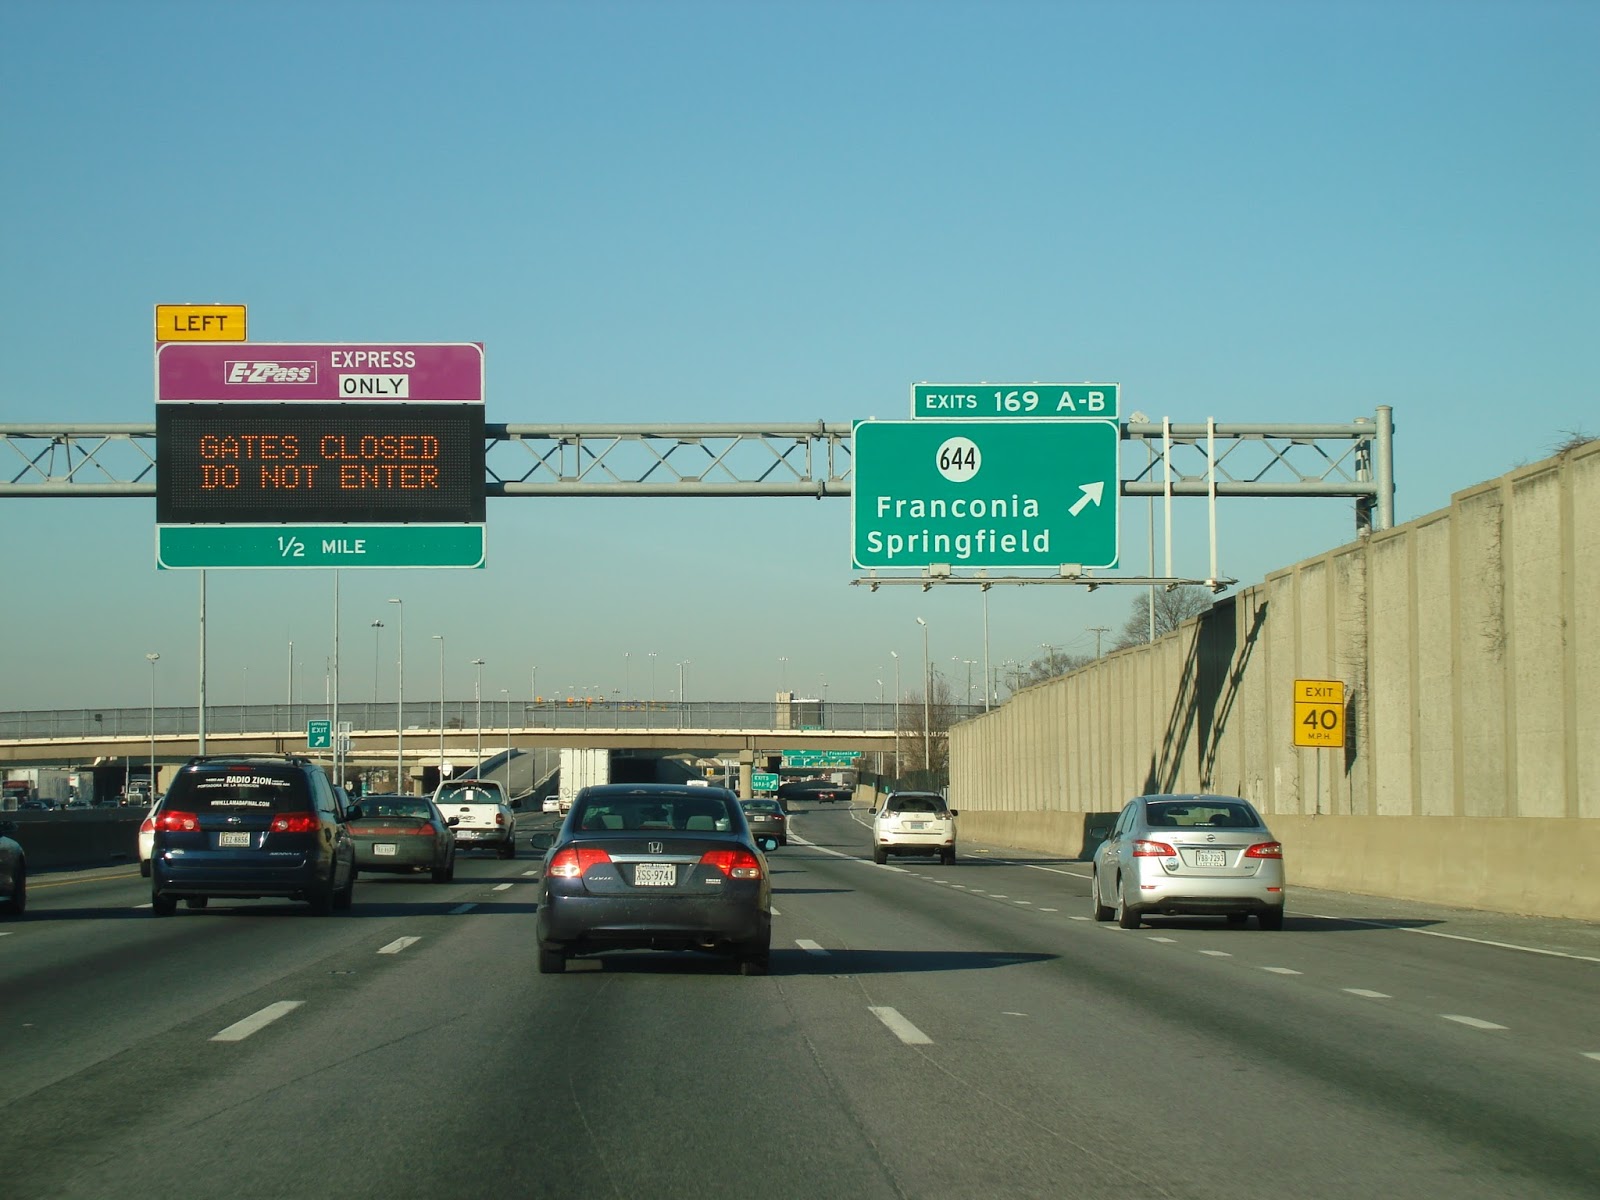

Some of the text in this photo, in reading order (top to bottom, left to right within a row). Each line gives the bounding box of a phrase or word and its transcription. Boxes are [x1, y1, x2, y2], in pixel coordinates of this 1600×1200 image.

[174, 315, 228, 331] LEFT
[331, 351, 416, 368] EXPRESS
[228, 362, 311, 383] E-ZPass
[343, 378, 404, 394] ONLY
[926, 391, 1105, 411] EXITS 169 A-B
[200, 435, 440, 459] GATES CLOSED
[940, 447, 976, 470] 644
[200, 465, 440, 489] DO NOT ENTER
[877, 494, 1039, 518] Franconia
[322, 540, 366, 554] MILE
[867, 529, 1049, 559] Springfield
[1306, 687, 1334, 697] EXIT
[1303, 709, 1337, 730] 40
[226, 776, 251, 784] RADIO
[252, 776, 272, 785] ZION
